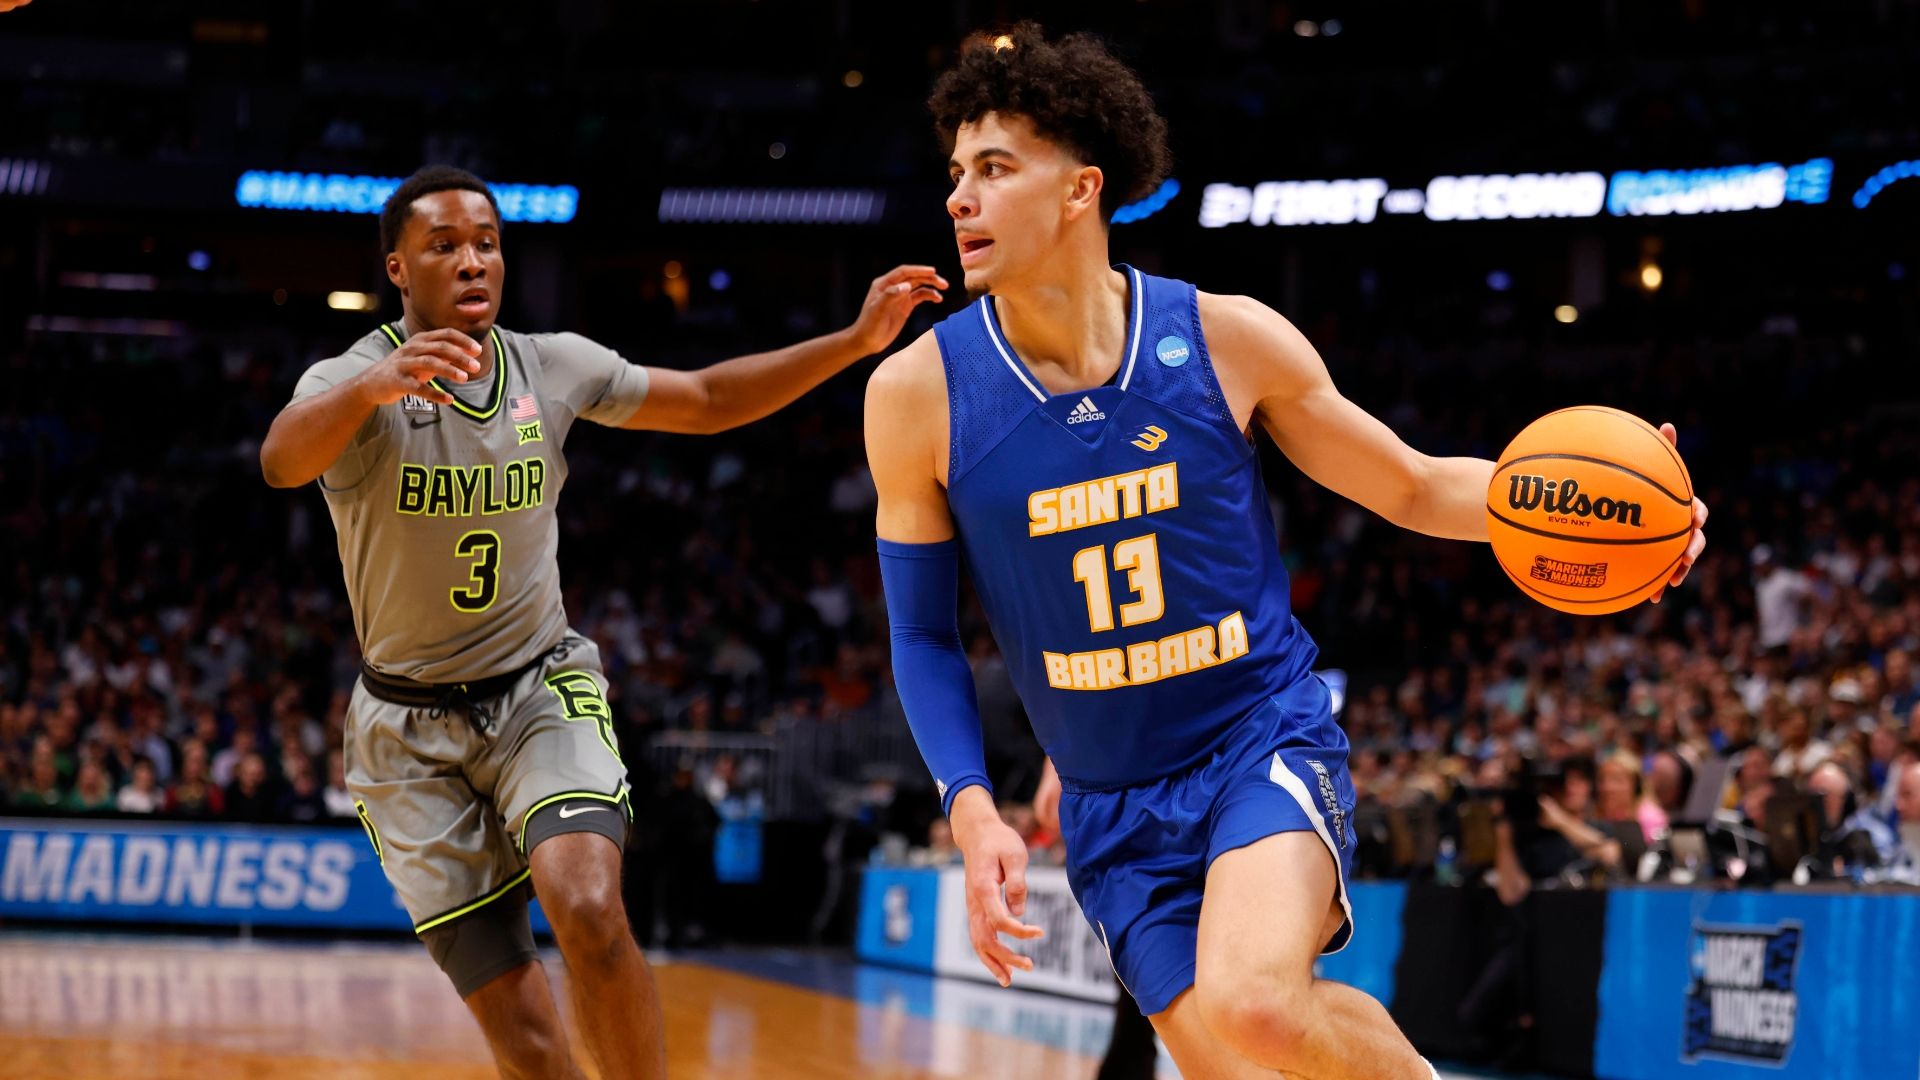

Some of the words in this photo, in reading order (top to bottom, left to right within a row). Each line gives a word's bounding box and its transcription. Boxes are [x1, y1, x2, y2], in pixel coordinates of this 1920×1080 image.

[1161, 347, 1189, 361] NCAA
[519, 425, 539, 440] XII
[1067, 411, 1106, 425] adidas
[396, 457, 546, 516] BAYLOR
[1028, 462, 1180, 537] SANTA
[1508, 474, 1642, 528] Wilson
[1548, 515, 1568, 525] EVO
[1570, 518, 1592, 528] NXT
[450, 529, 501, 613] 3
[1073, 533, 1165, 633] 13
[1546, 560, 1586, 575] MARCH
[1550, 570, 1605, 586] MADNESS
[1043, 610, 1249, 691] BARBARA
[2, 832, 356, 912] MADNESS
